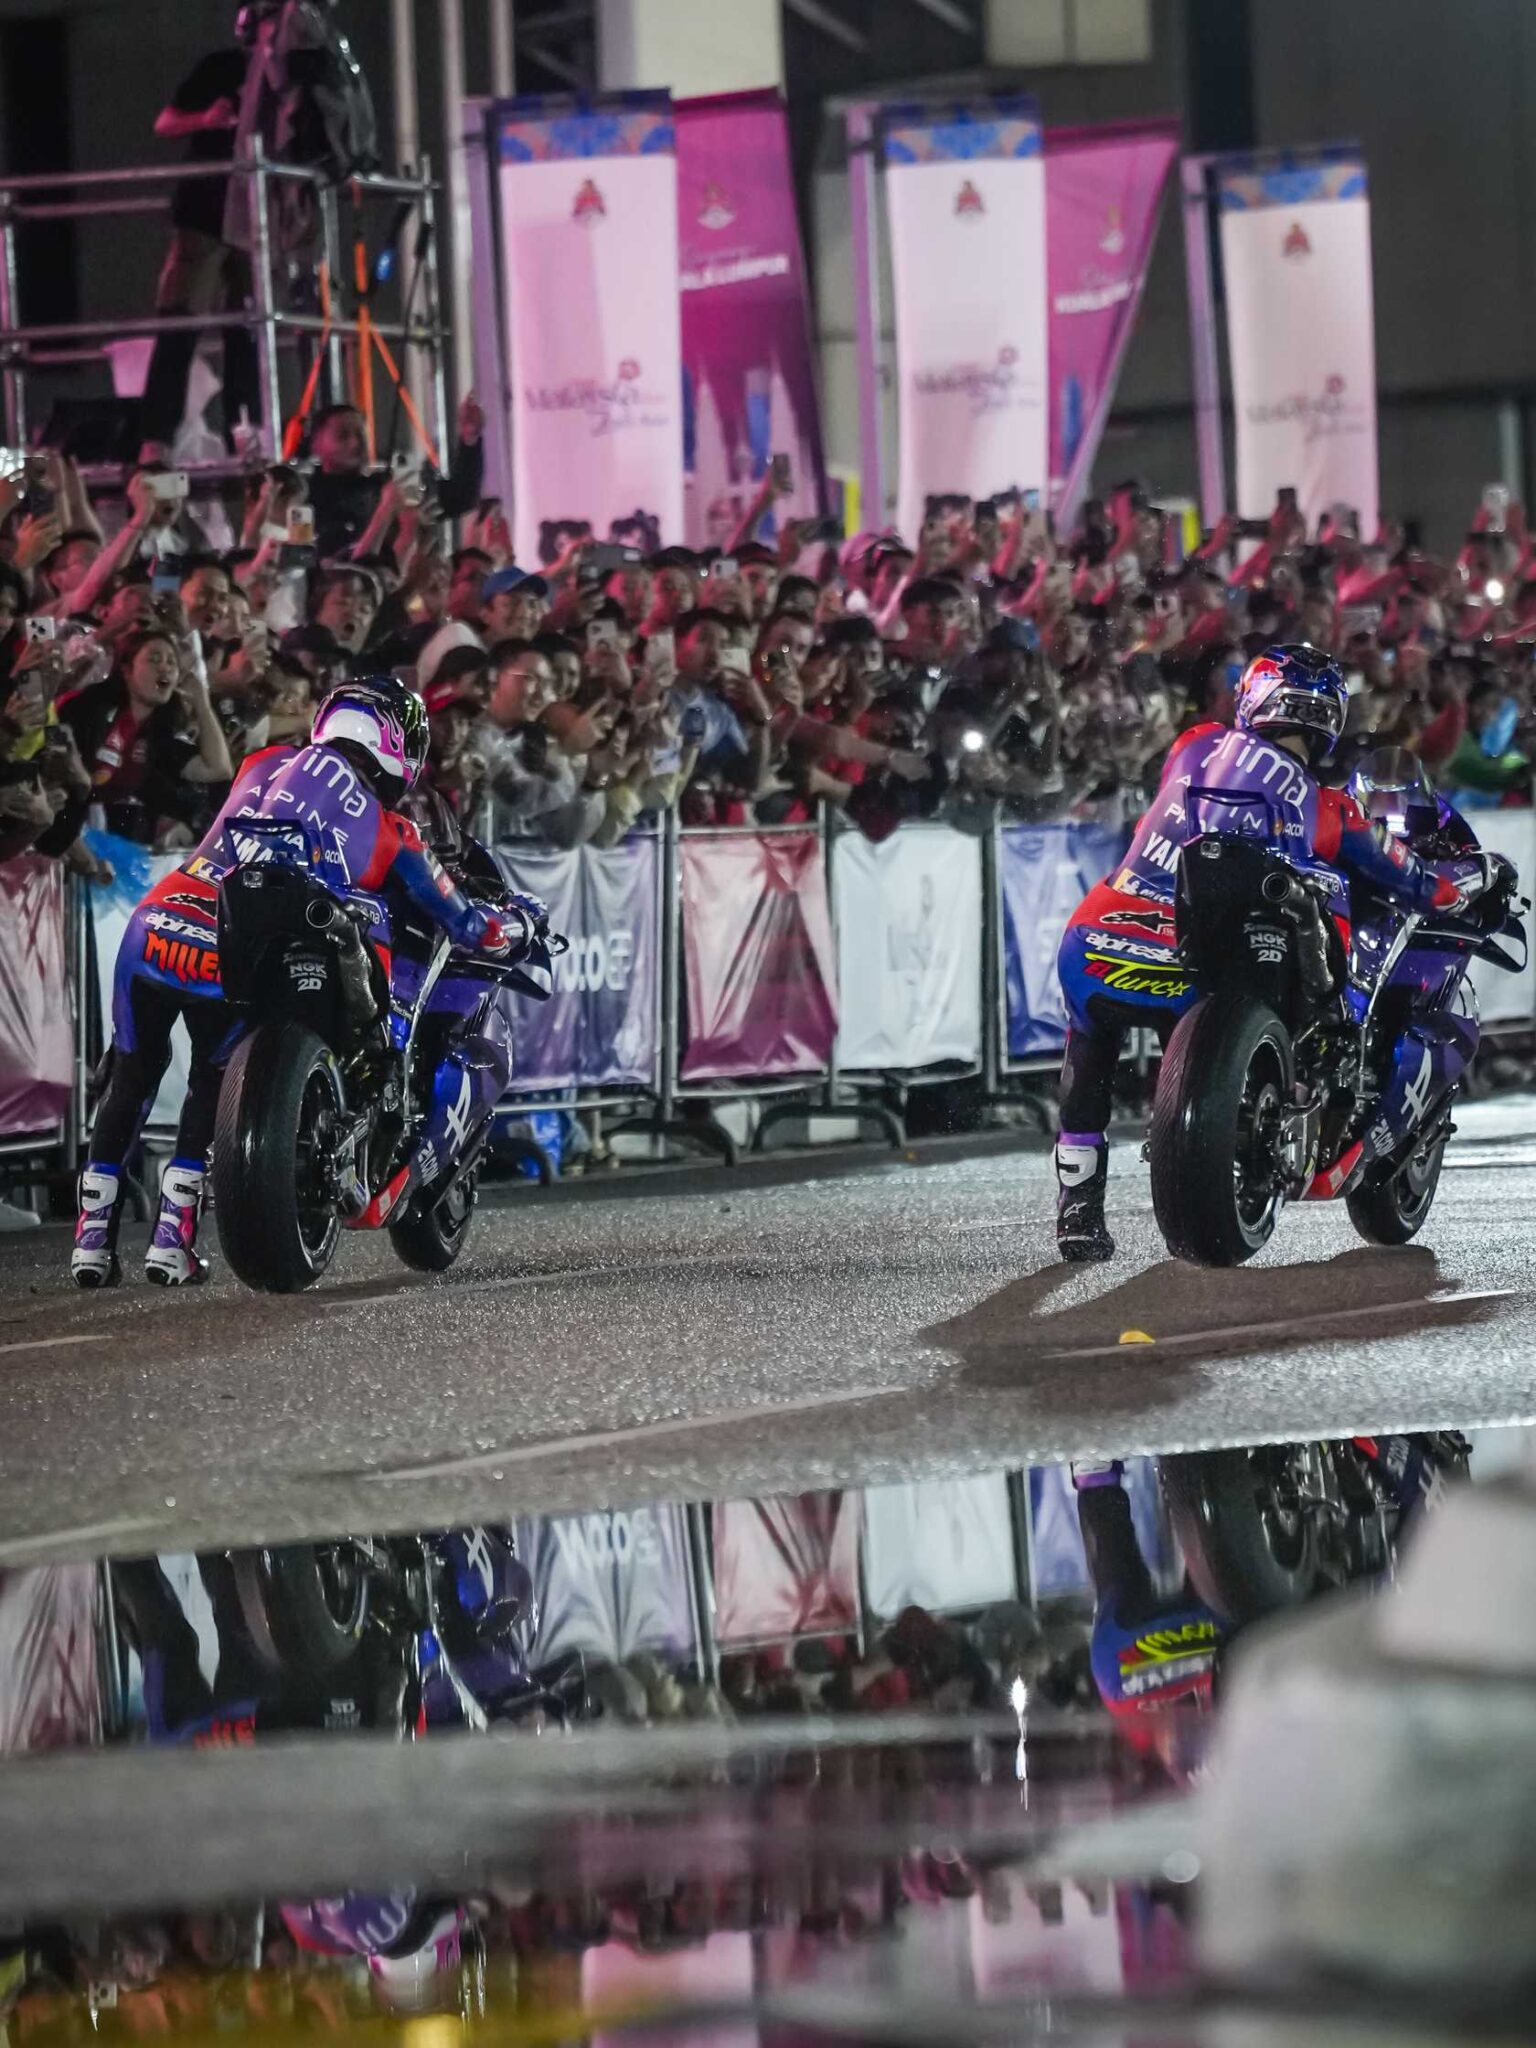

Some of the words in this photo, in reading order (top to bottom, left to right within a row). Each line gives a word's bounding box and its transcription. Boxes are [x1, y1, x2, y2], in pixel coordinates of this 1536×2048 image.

[1250, 932, 1288, 949] NGK
[144, 931, 222, 985] MILLE
[1256, 949, 1283, 963] 2D
[297, 978, 322, 992] 2D
